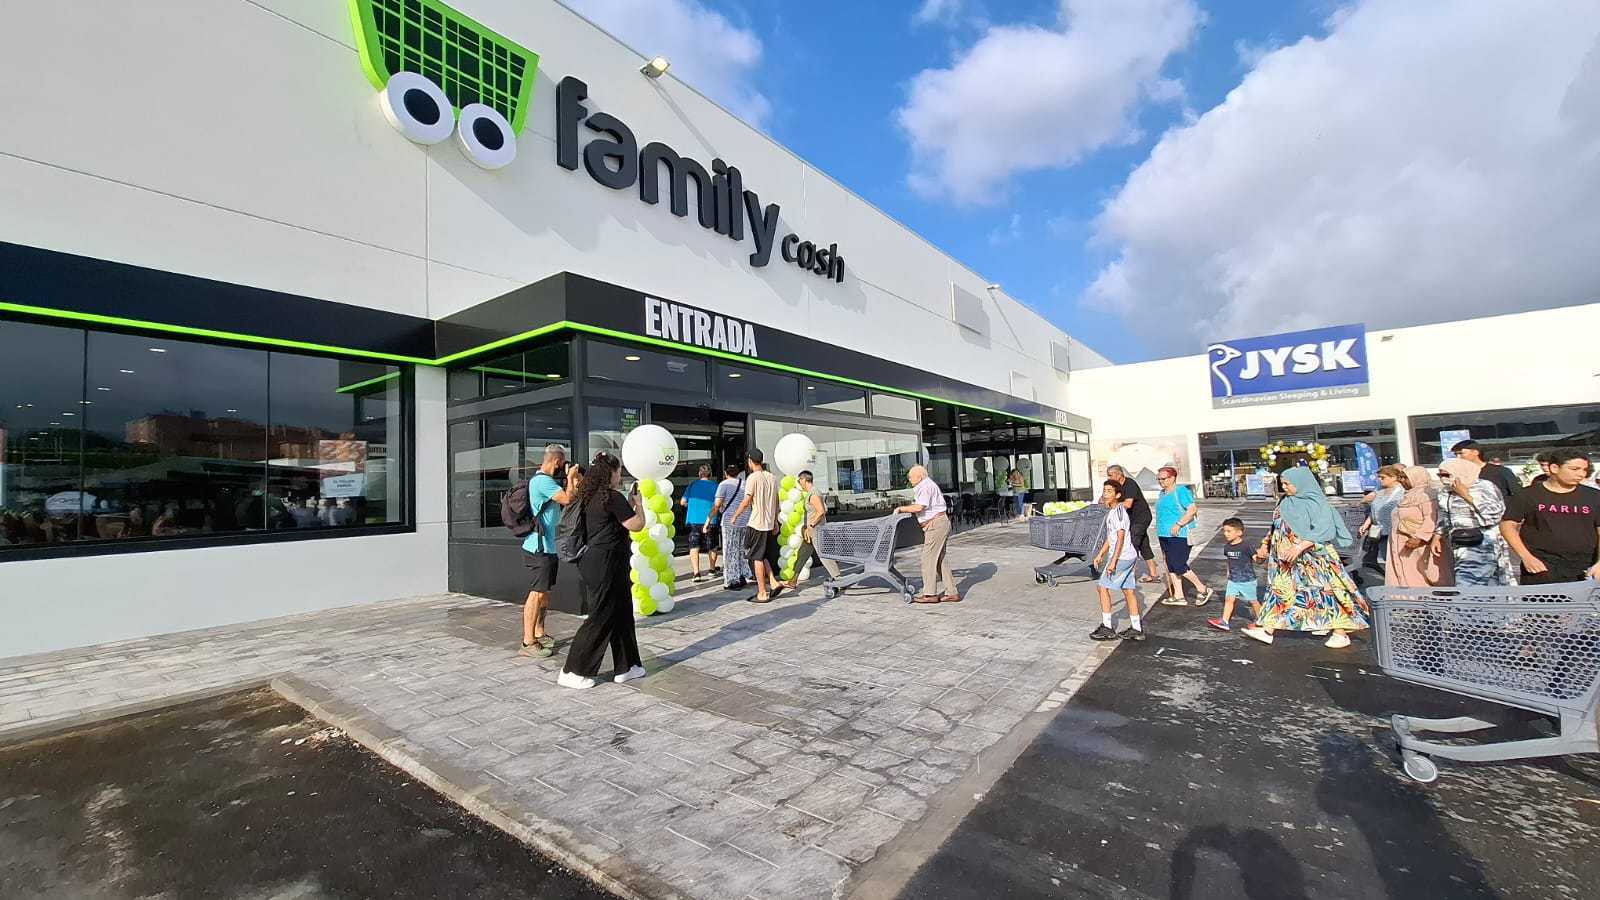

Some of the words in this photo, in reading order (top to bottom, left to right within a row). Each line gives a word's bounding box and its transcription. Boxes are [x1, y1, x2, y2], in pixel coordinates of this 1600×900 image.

[555, 75, 781, 267] family
[781, 232, 846, 283] cash
[645, 296, 758, 358] ENTRADA
[1239, 337, 1361, 380] JYSK
[1221, 394, 1278, 405] Scandinavian
[1279, 390, 1319, 400] Sleeping
[1320, 389, 1328, 397] &
[1329, 387, 1359, 397] Living
[1538, 504, 1590, 514] PARIS
